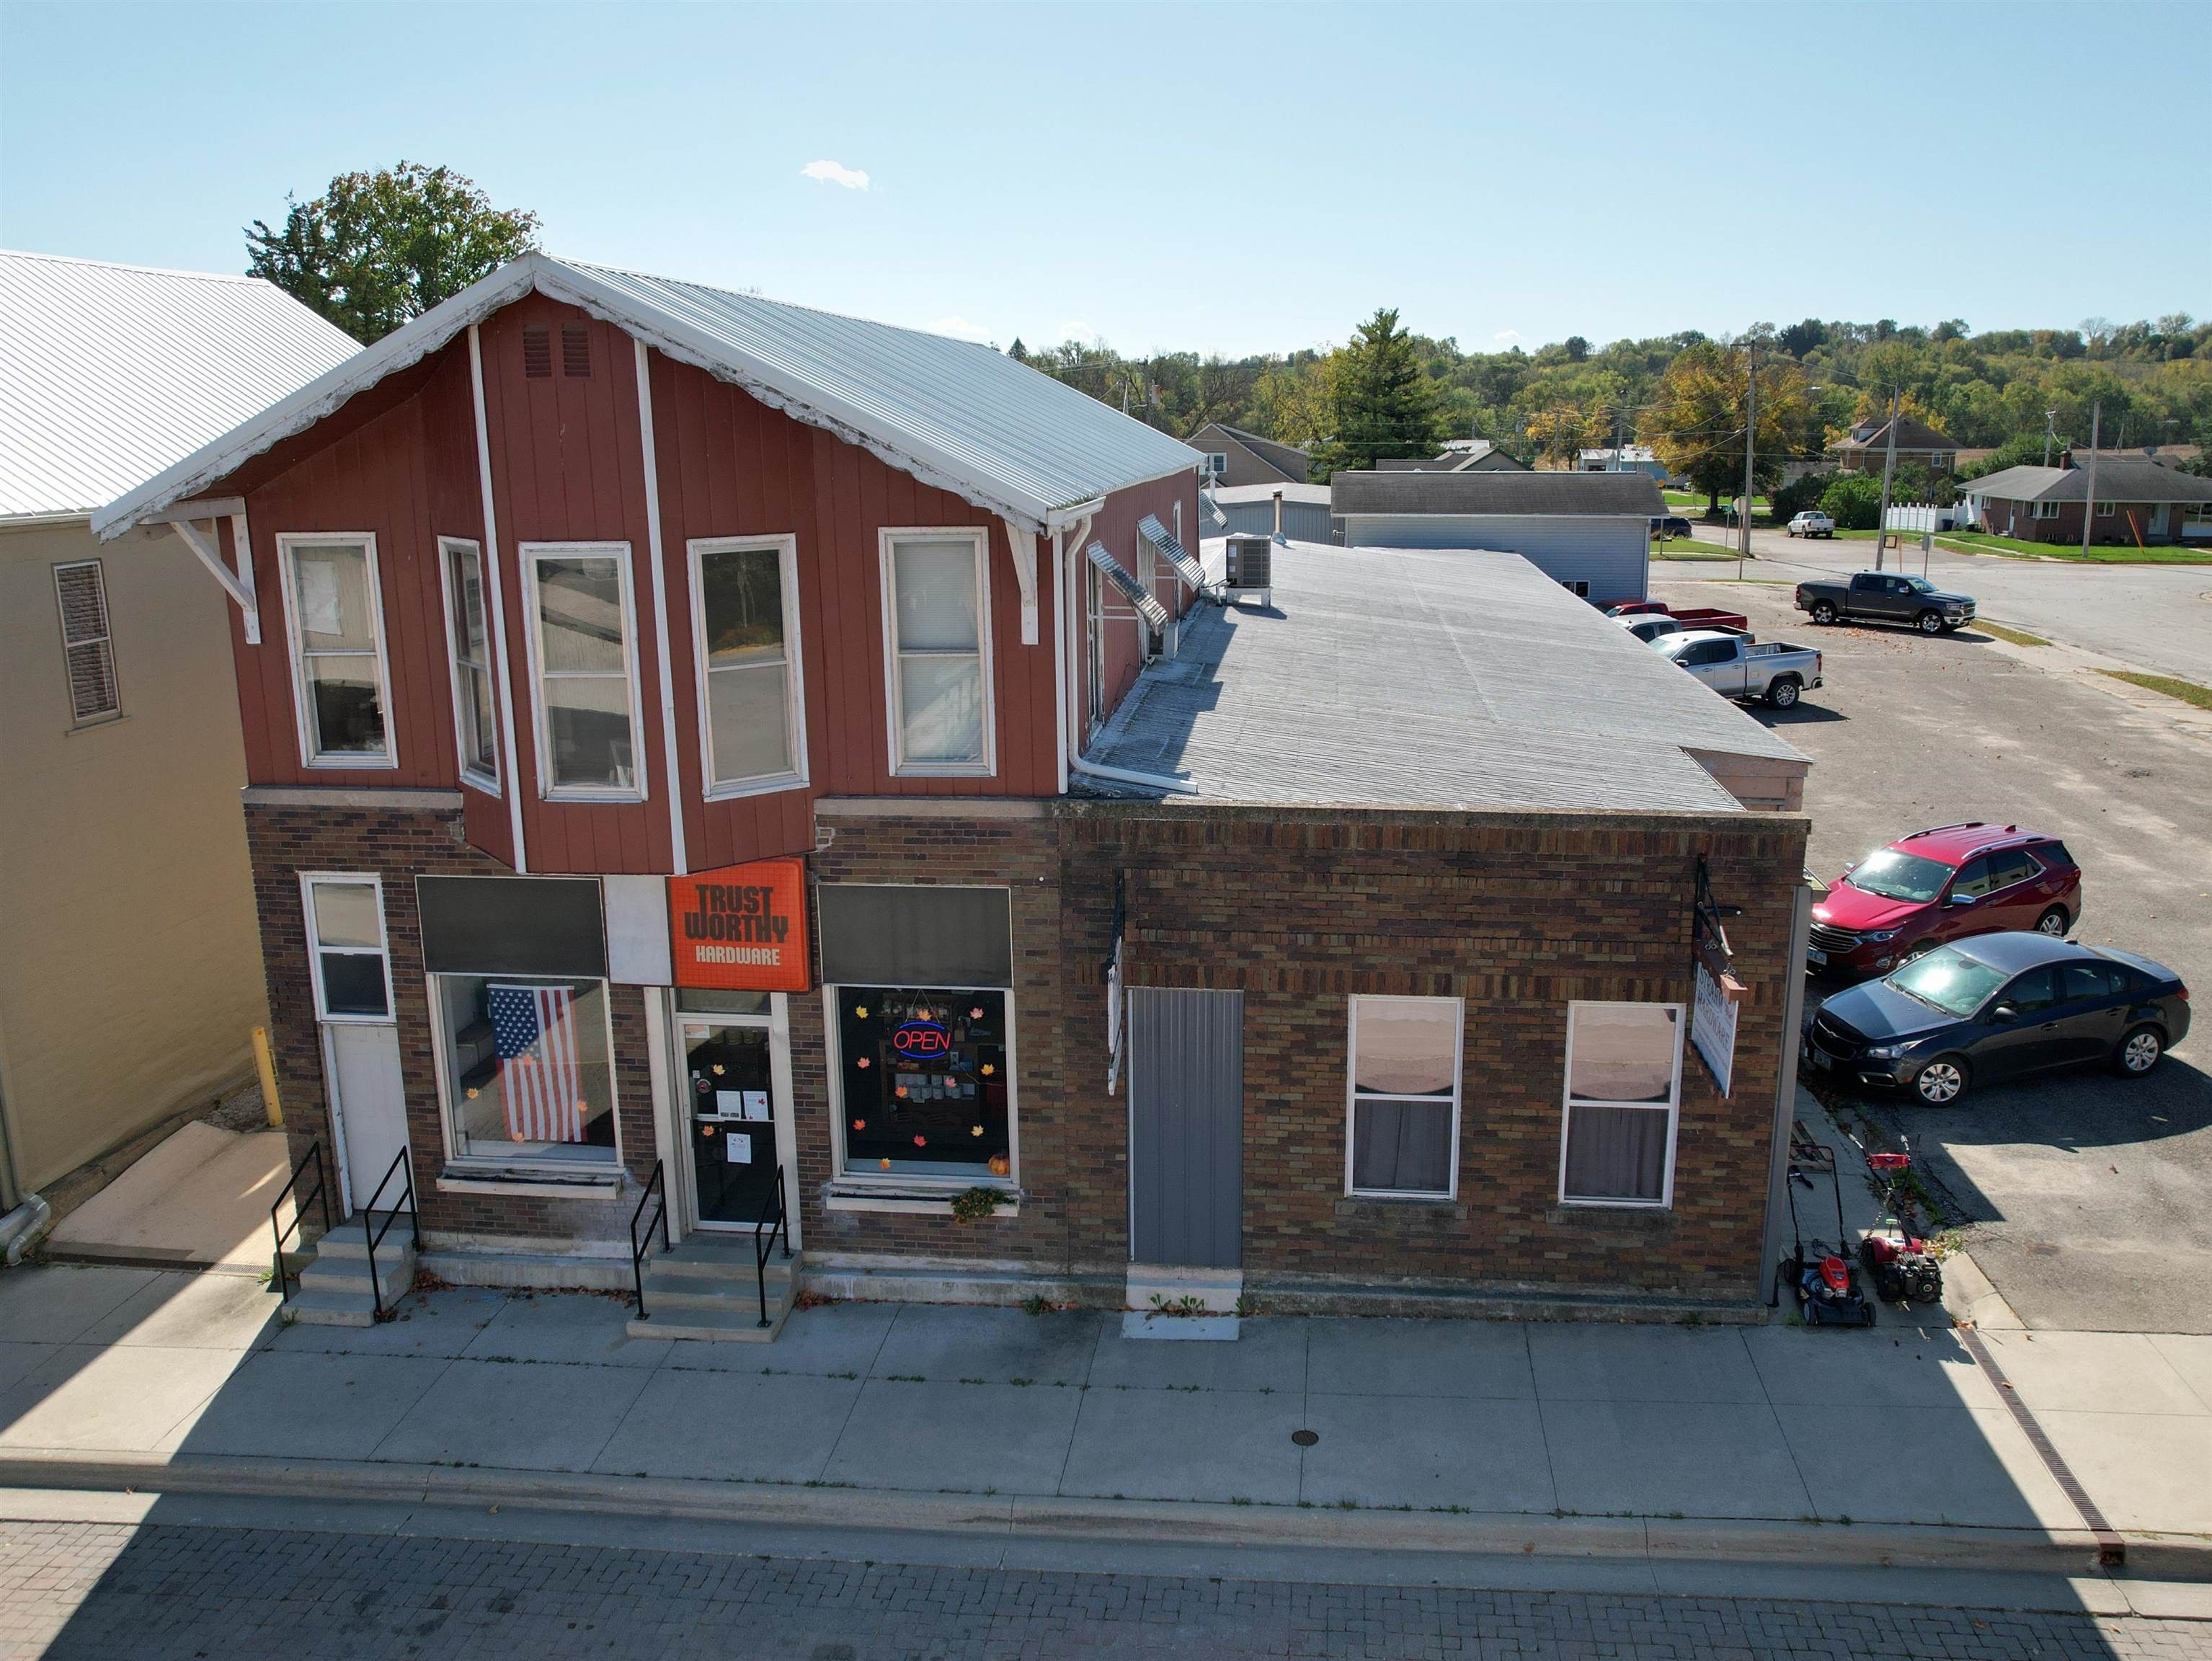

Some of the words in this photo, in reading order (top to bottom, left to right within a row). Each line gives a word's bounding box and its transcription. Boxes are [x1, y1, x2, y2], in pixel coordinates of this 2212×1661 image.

[696, 884, 773, 913] TRUST
[685, 911, 789, 944] WORTHY
[696, 945, 781, 966] HARDWARE
[893, 1030, 951, 1050] OPEN
